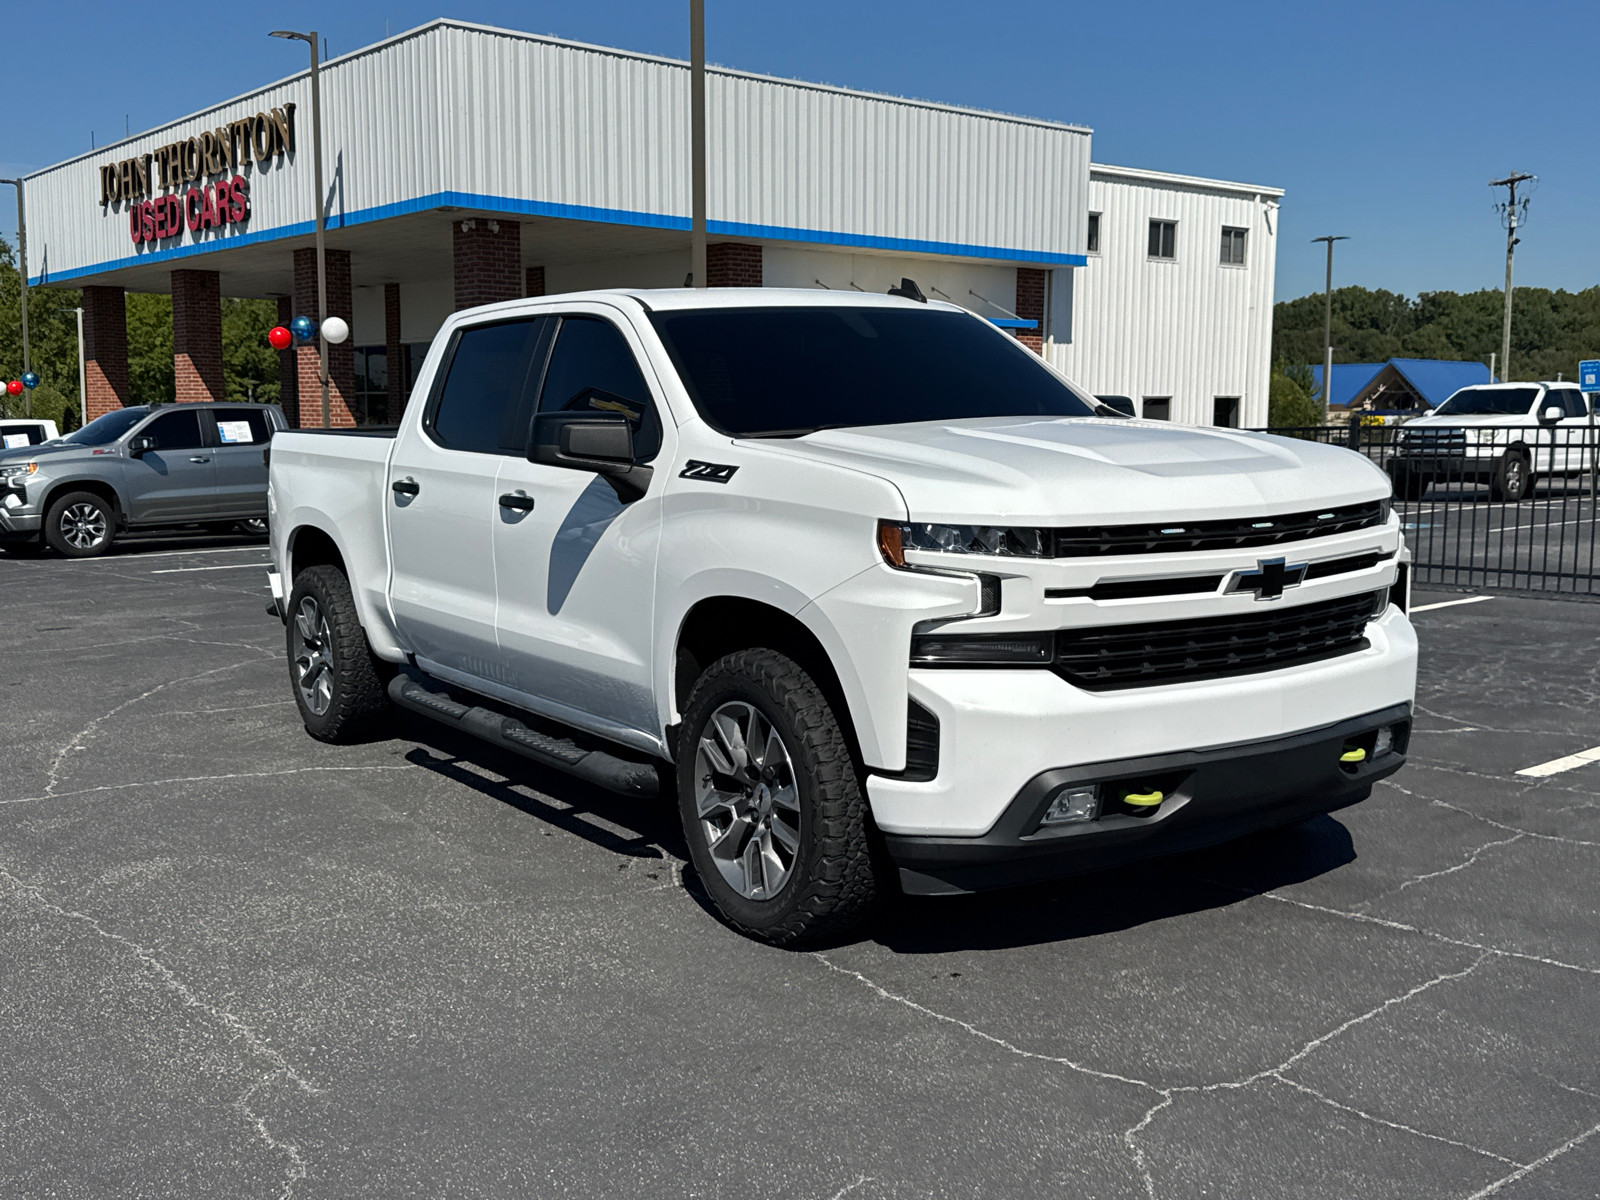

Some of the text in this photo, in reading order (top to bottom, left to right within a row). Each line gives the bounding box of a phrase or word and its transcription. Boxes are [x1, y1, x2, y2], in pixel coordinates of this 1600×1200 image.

[99, 102, 296, 207] JOHN THORNTON
[130, 174, 249, 244] USED CARS
